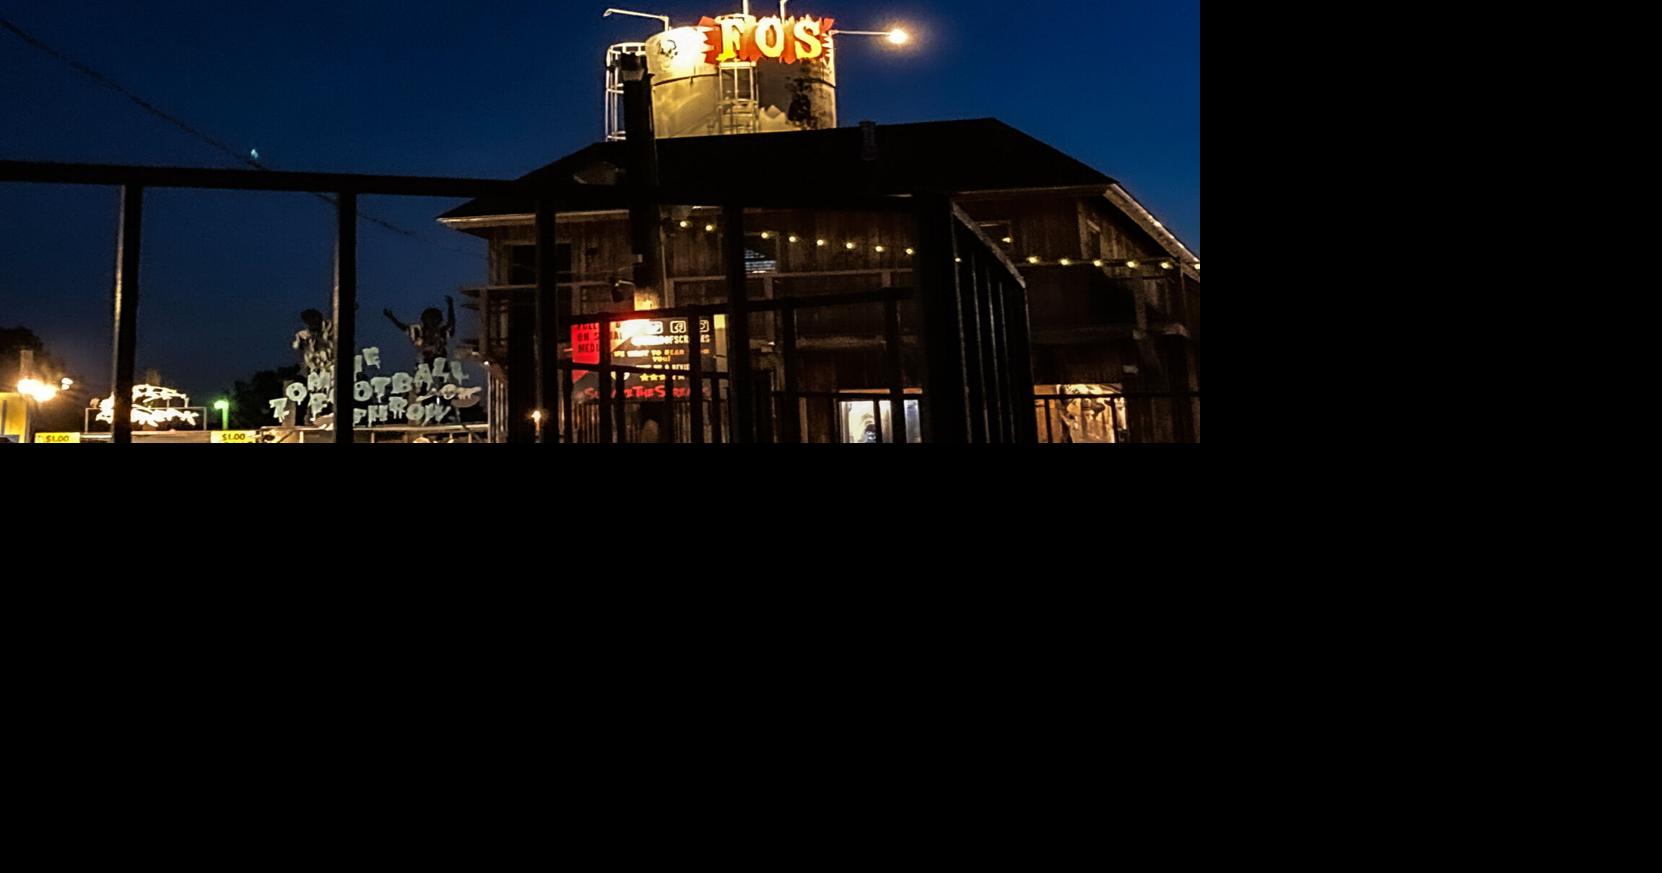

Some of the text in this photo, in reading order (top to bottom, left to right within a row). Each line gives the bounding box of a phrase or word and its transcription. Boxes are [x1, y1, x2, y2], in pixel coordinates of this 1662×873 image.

[717, 15, 823, 61] FOS
[578, 343, 600, 353] MEDI
[45, 434, 70, 443] $1.00
[221, 432, 246, 442] $1.00
